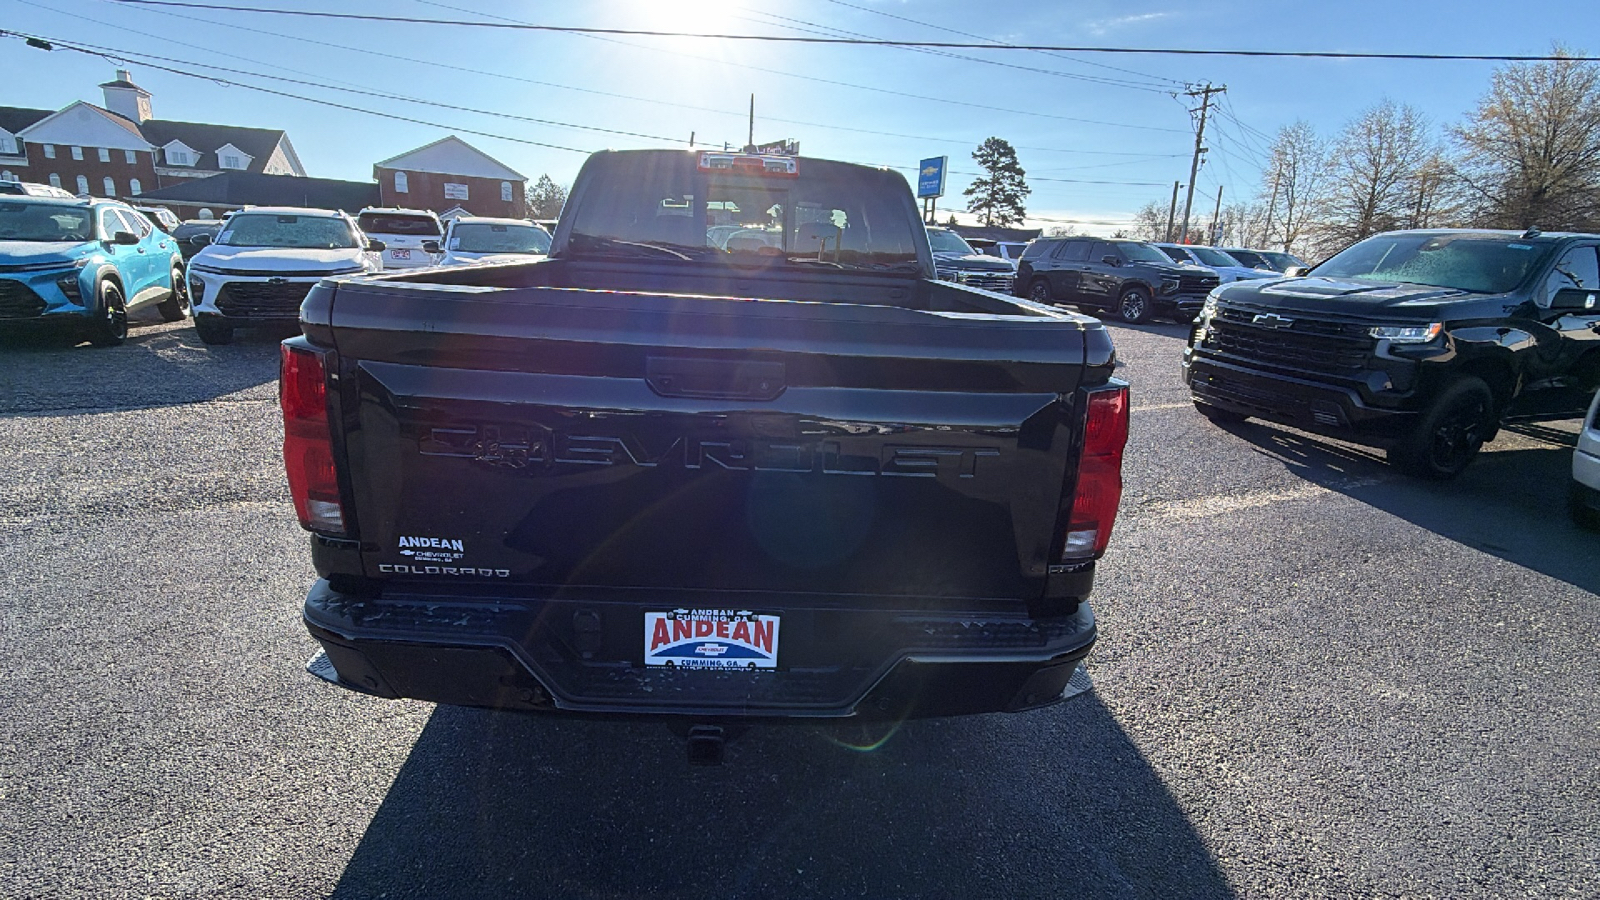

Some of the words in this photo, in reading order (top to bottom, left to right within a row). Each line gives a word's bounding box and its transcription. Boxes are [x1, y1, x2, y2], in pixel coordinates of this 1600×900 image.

[398, 536, 464, 552] ANDEAN
[416, 551, 464, 559] CHEVROLET
[379, 564, 510, 578] COLORADO
[676, 614, 730, 622] CUMMING,
[650, 617, 774, 654] ANDEAN
[681, 659, 725, 668] CUMMING,
